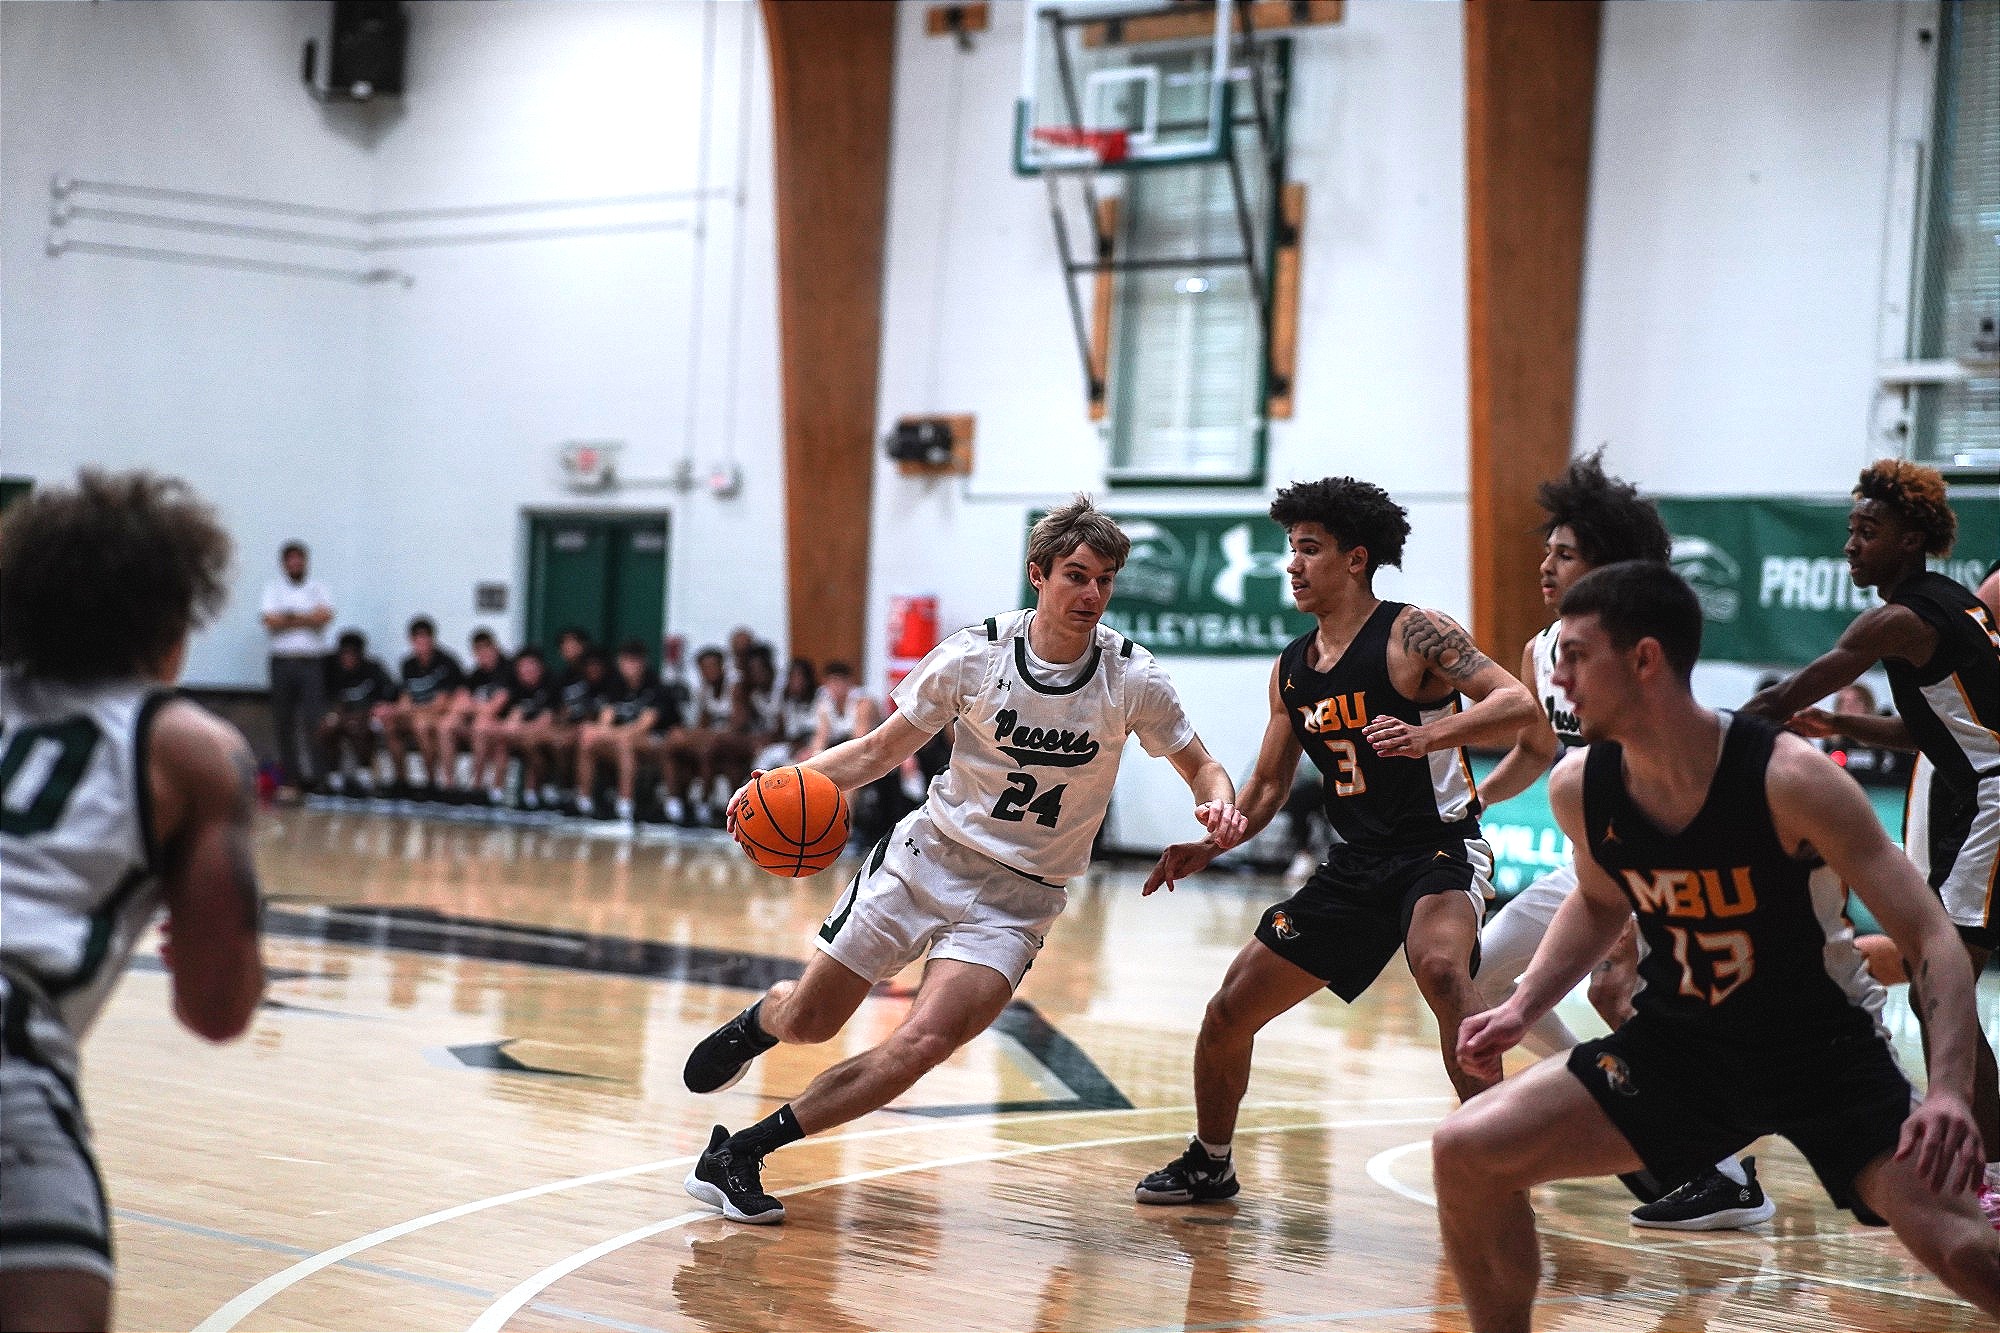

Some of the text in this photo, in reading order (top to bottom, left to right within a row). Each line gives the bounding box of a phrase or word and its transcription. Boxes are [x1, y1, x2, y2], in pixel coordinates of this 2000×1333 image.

[1758, 555, 1887, 612] PROT
[1099, 611, 1297, 649] LLEYBALL
[994, 708, 1100, 758] Pacers
[1297, 691, 1368, 734] MBU
[1324, 739, 1367, 797] 3
[991, 772, 1068, 828] 24
[1620, 866, 1757, 918] MBU
[1664, 925, 1755, 1007] 13
